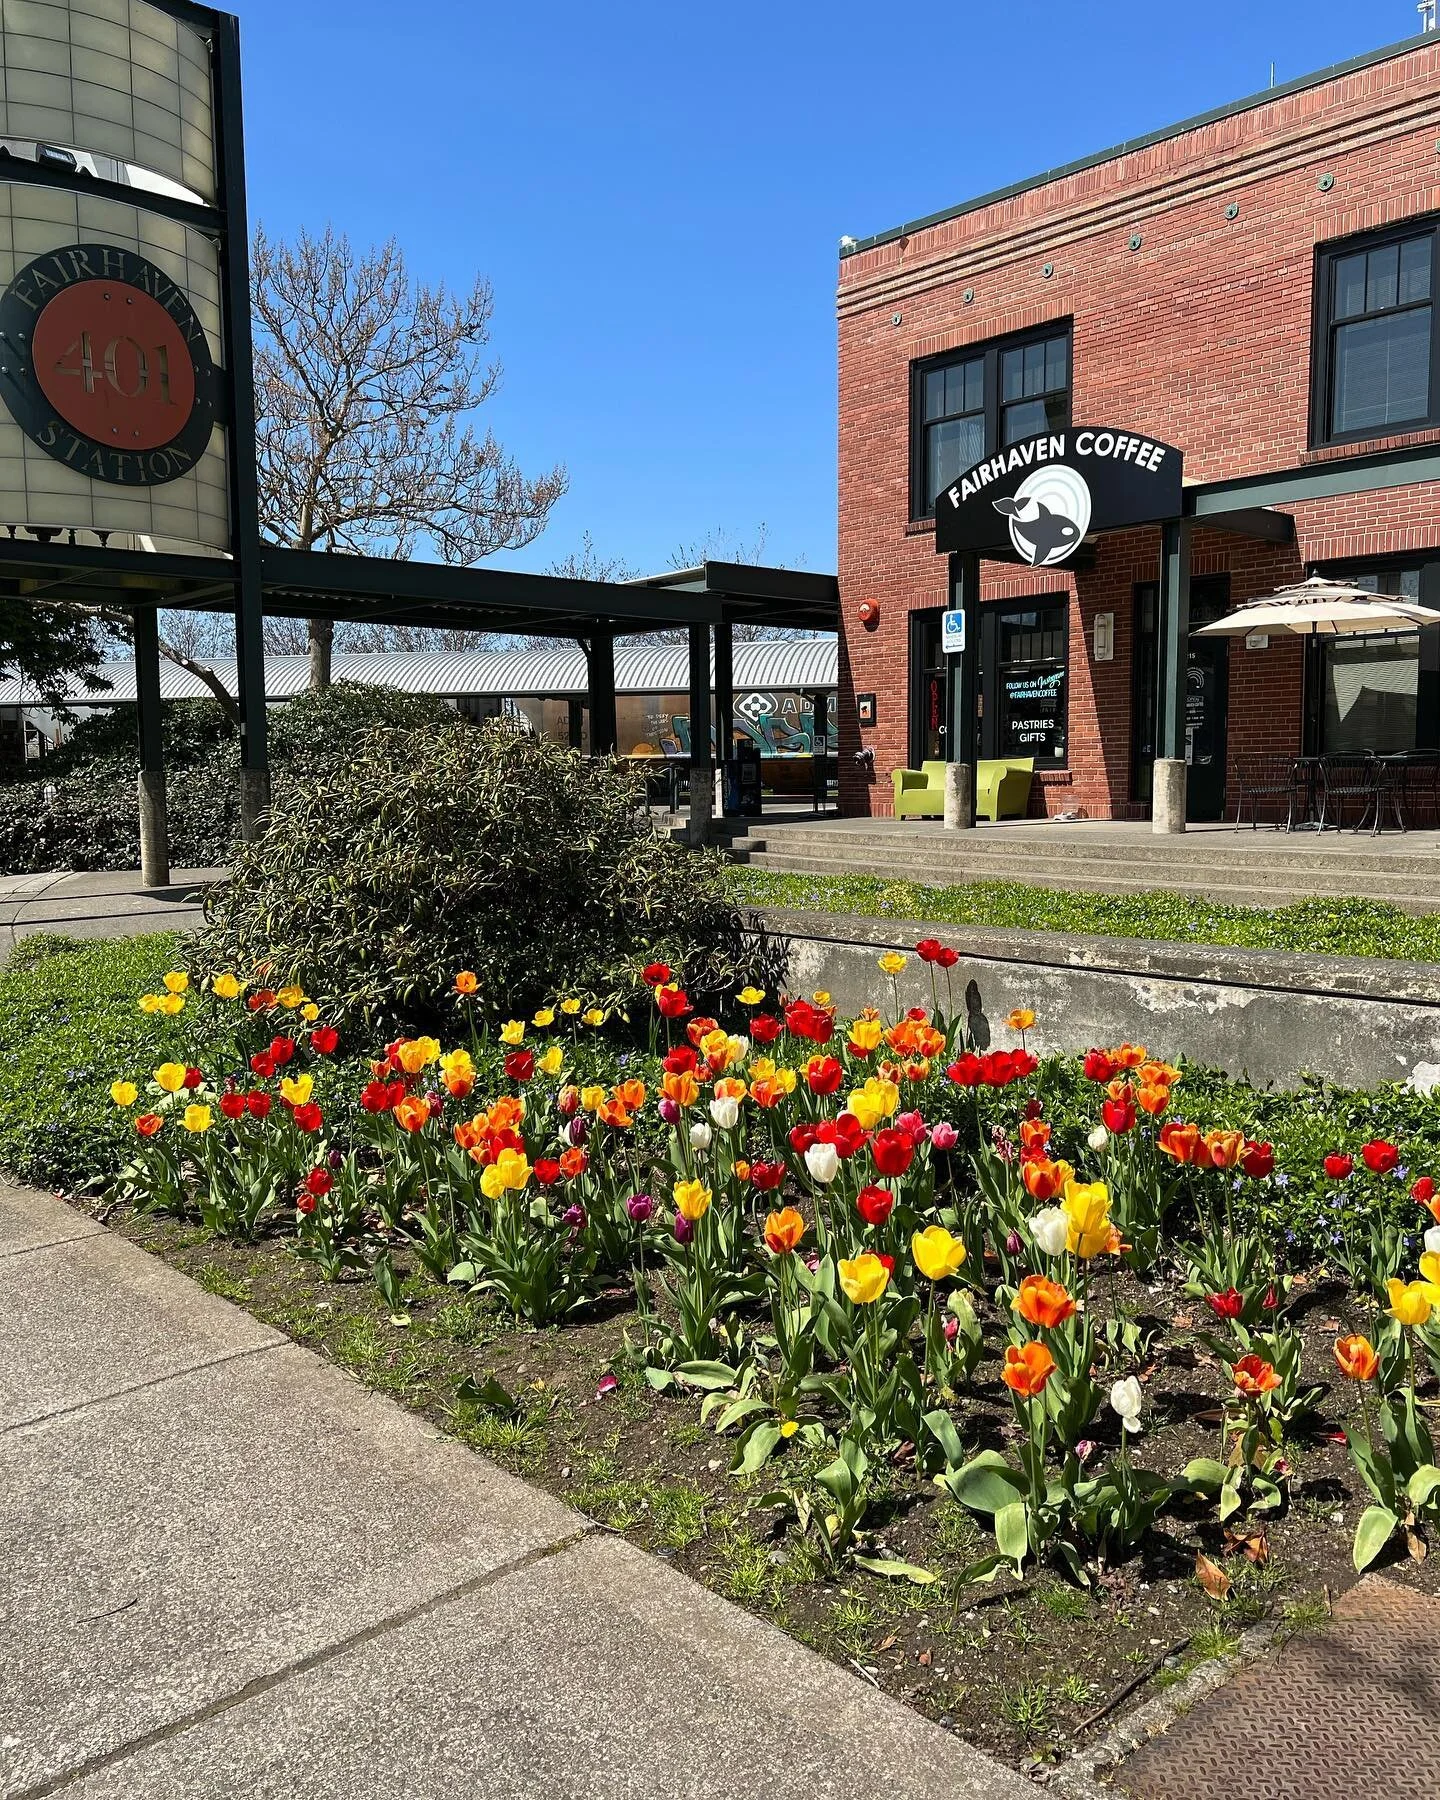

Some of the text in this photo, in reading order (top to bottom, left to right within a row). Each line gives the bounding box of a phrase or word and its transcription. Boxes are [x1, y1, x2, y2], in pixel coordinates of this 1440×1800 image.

[10, 249, 202, 343] FAIRHAVEN
[53, 330, 179, 406] 401
[35, 421, 193, 483] STATION
[948, 432, 1166, 509] FAIRHAVEN COFFEE
[1006, 682, 1022, 690] FOLLOW
[1023, 681, 1029, 689] US
[1009, 688, 1058, 699] @FAIRHAVENCOFFEE
[1011, 719, 1055, 730] PASTRIES
[1019, 732, 1046, 743] GIFTS
